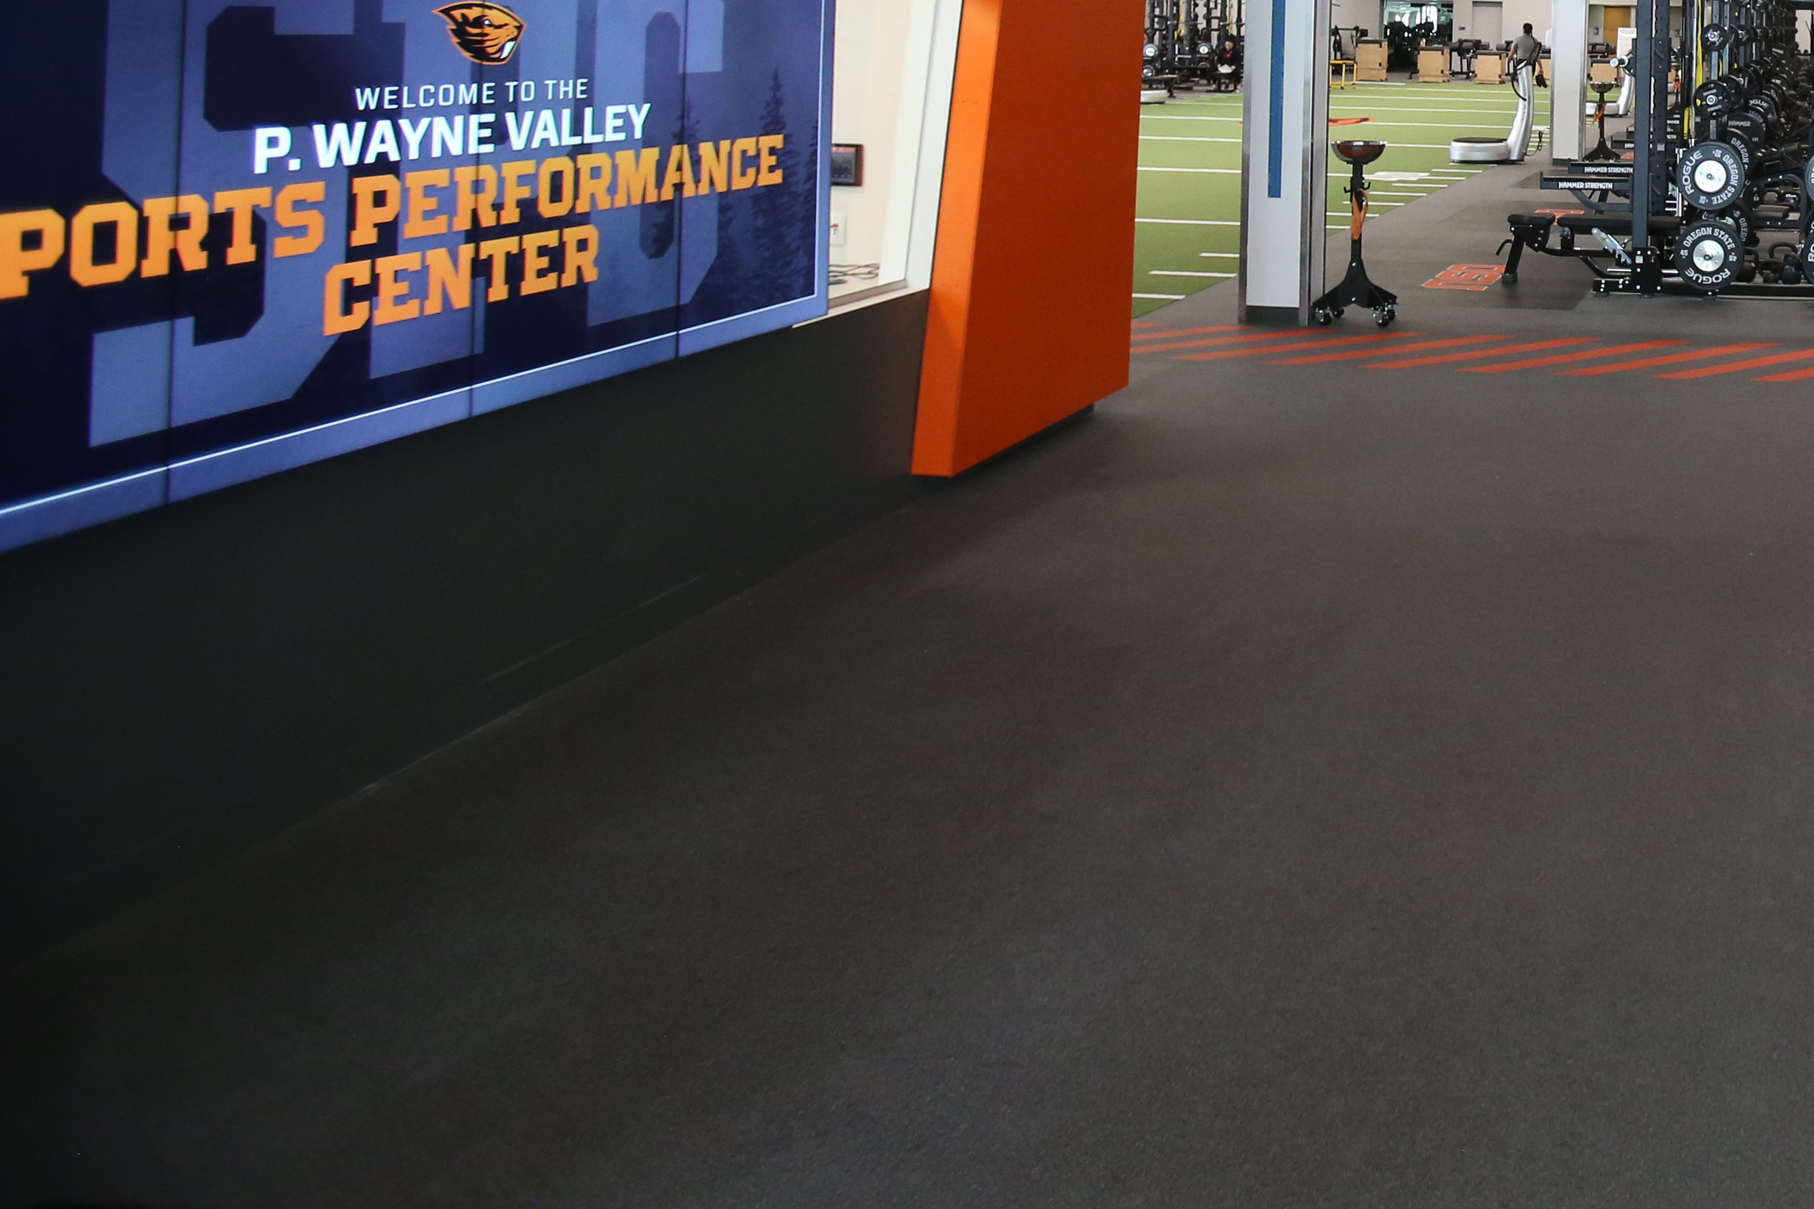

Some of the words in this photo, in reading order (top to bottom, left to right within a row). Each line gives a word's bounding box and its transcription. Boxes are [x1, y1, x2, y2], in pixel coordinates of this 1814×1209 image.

[355, 82, 496, 111] WELCOME
[504, 80, 536, 103] TO
[544, 78, 589, 100] THE
[253, 125, 302, 174] P.
[312, 113, 496, 169] WAYNE
[504, 103, 651, 151] VALLEY
[1682, 150, 1703, 194] ROGUE
[1722, 154, 1738, 186] OREGON
[349, 134, 784, 247] PERFORMANCE
[1711, 186, 1735, 204] STATE
[1683, 227, 1712, 247] OREGON
[1713, 229, 1735, 250] STATE
[323, 224, 600, 337] CENTER
[1684, 267, 1731, 284] ROGUE
